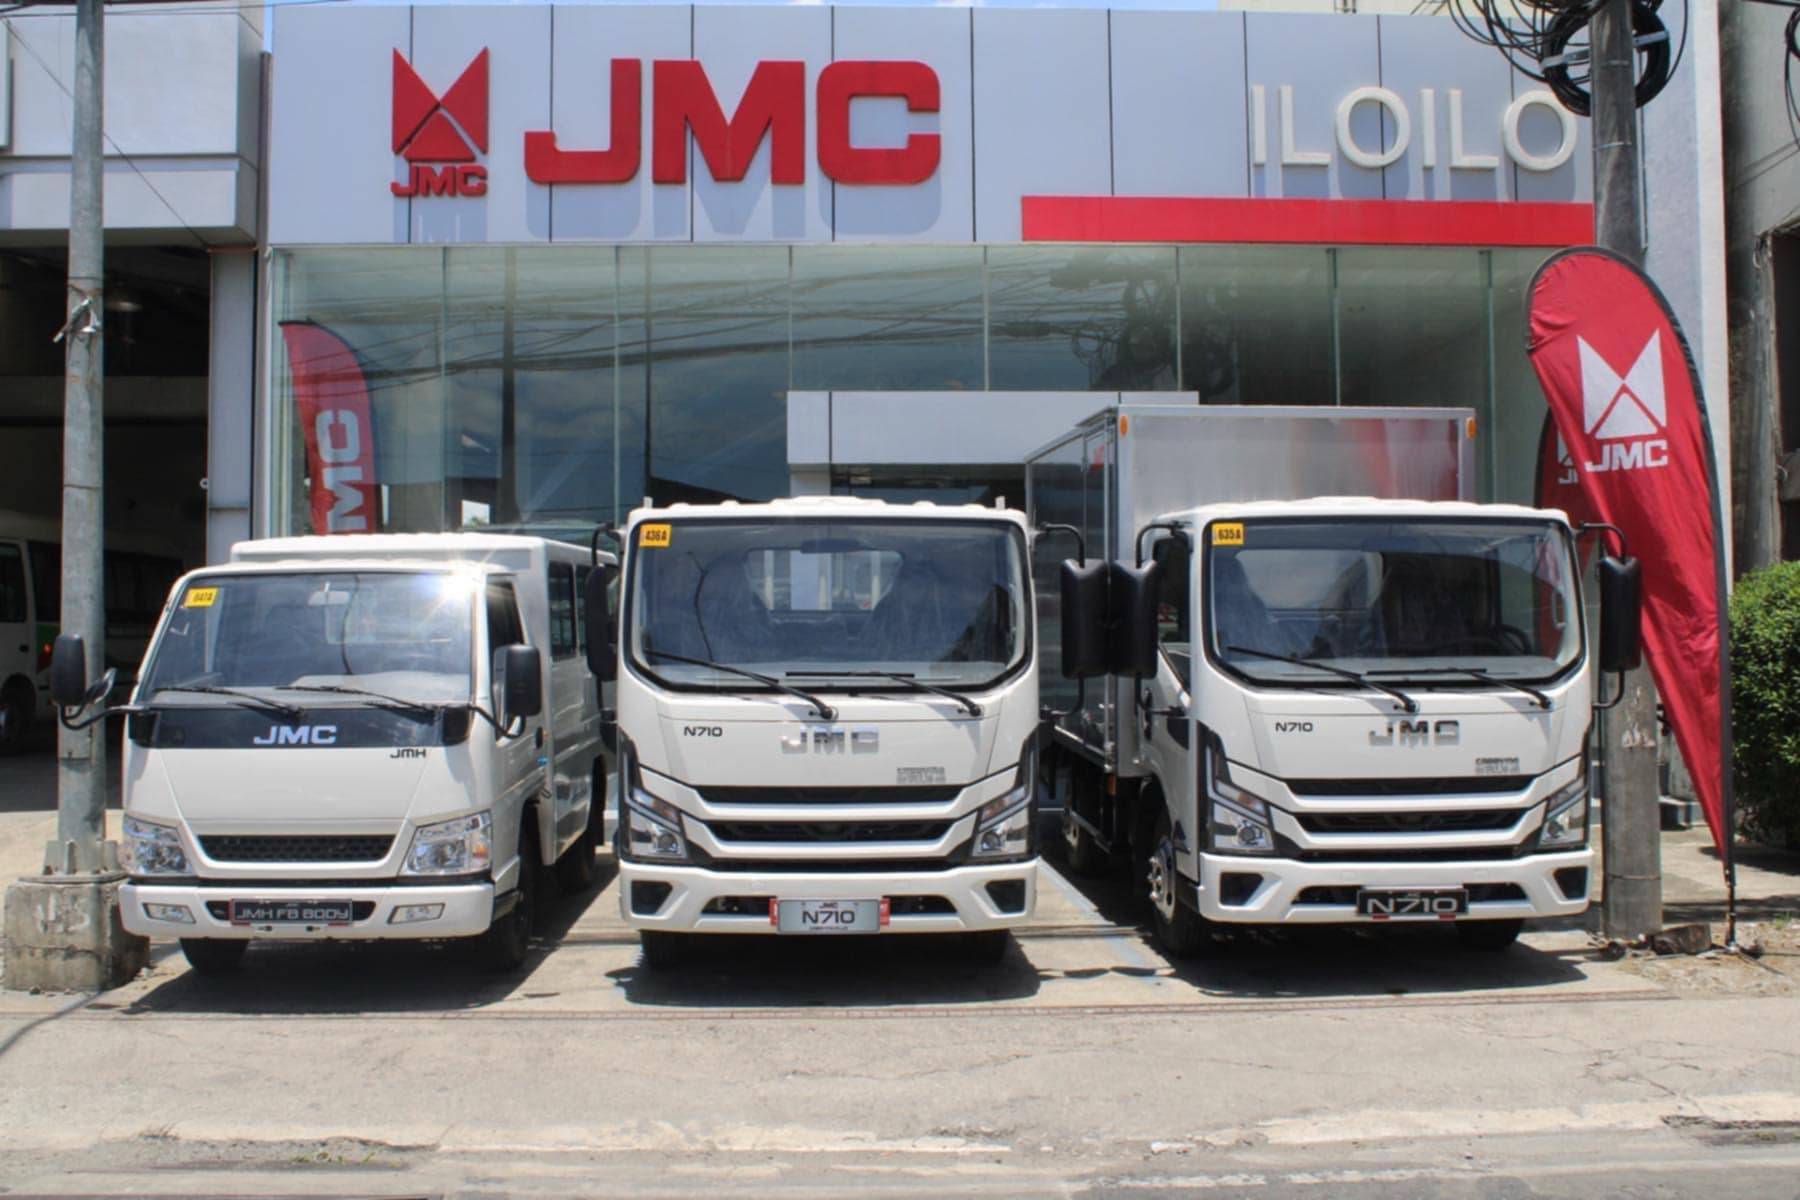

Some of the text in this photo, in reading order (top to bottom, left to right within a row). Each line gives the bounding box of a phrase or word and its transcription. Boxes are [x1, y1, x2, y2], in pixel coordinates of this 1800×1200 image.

[523, 57, 942, 185] JMC
[1251, 83, 1579, 172] ILOILO
[390, 163, 489, 199] JMC
[1584, 439, 1669, 473] JMC
[315, 408, 368, 533] MC
[252, 725, 338, 745] JMC
[683, 725, 723, 738] N710
[780, 724, 880, 754] JMC
[1275, 721, 1314, 733] N710
[1368, 719, 1461, 747] JMC
[389, 748, 427, 759] JMH
[236, 908, 273, 919] JMH
[302, 908, 349, 919] BODY
[801, 910, 856, 925] N710
[1366, 897, 1458, 914] N710
